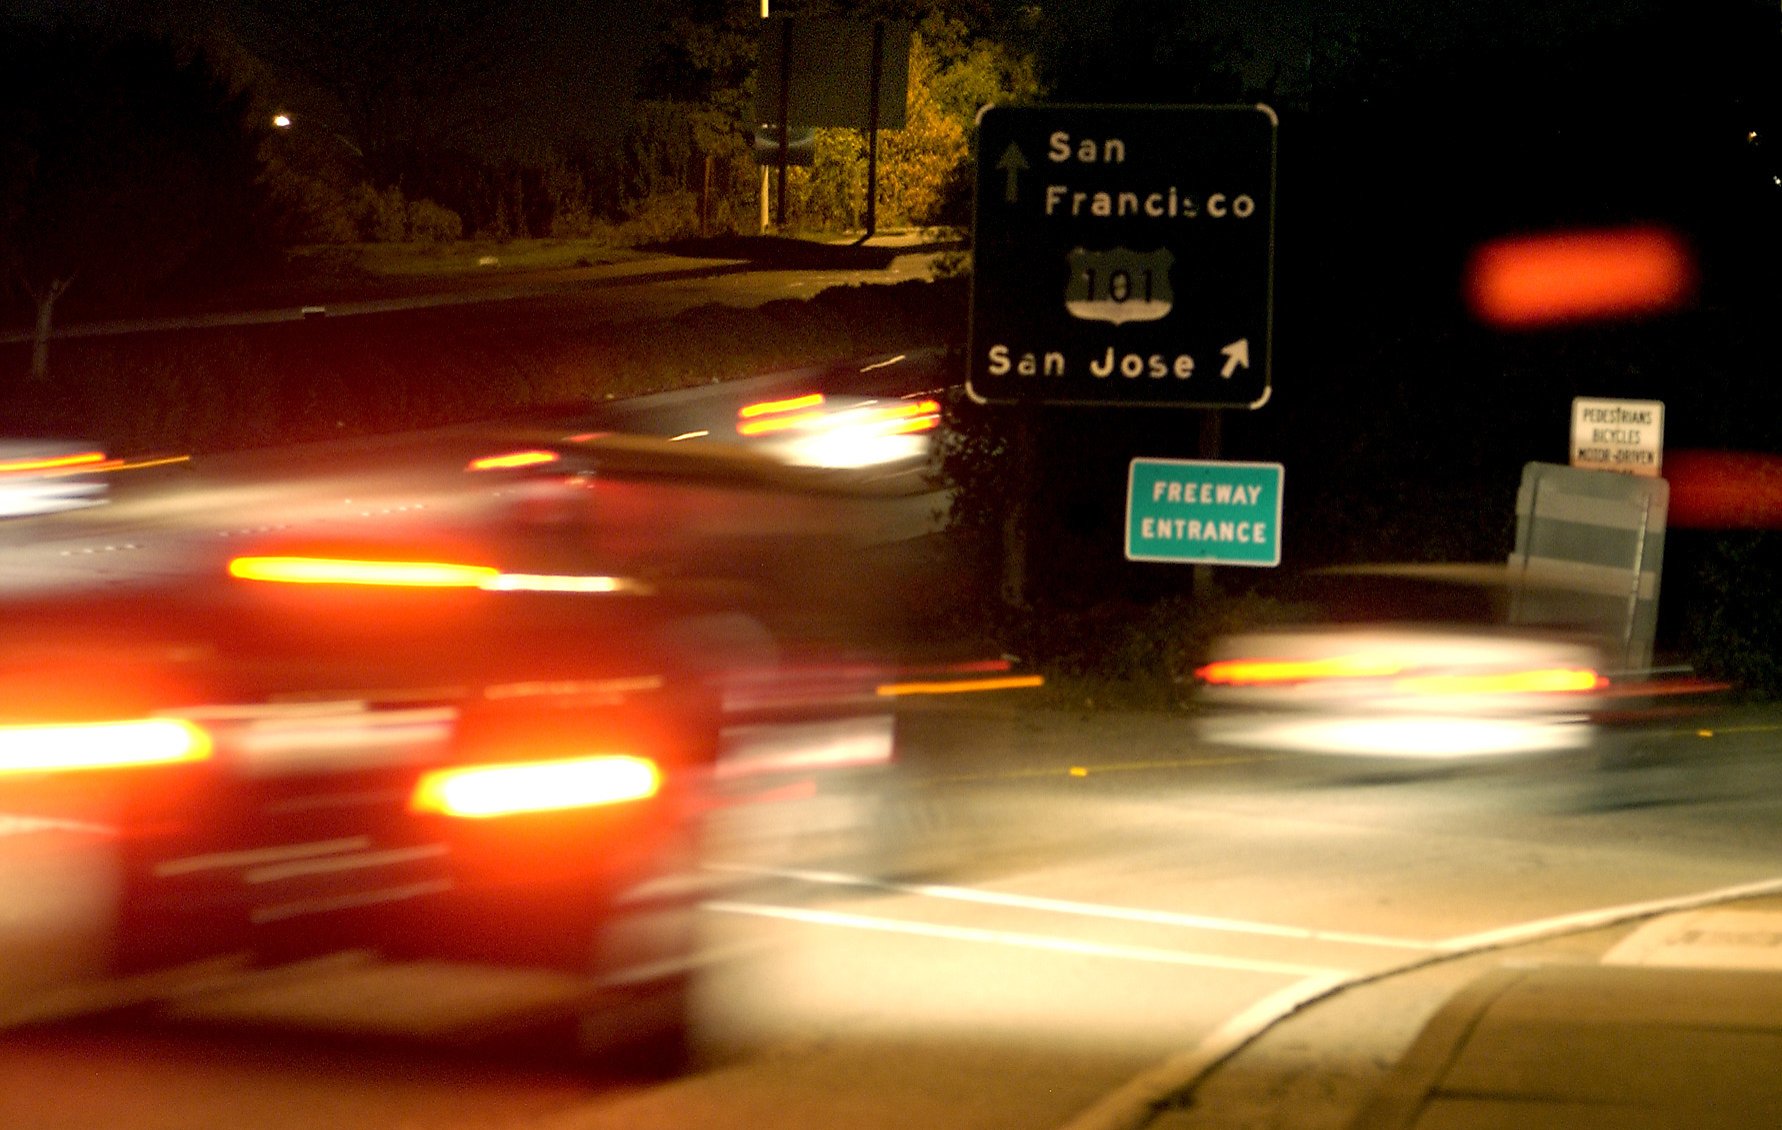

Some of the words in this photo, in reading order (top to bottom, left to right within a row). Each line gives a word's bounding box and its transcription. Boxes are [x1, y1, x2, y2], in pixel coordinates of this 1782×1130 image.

[1048, 131, 1125, 163] San
[1045, 185, 1255, 218] Francisco
[1084, 268, 1152, 304] 101
[987, 345, 1066, 376] San
[1089, 347, 1195, 379] Jose
[1583, 408, 1652, 425] PEDESTRIANS
[1152, 480, 1262, 506] FREEWAY
[1141, 517, 1267, 544] ENTRANCE
